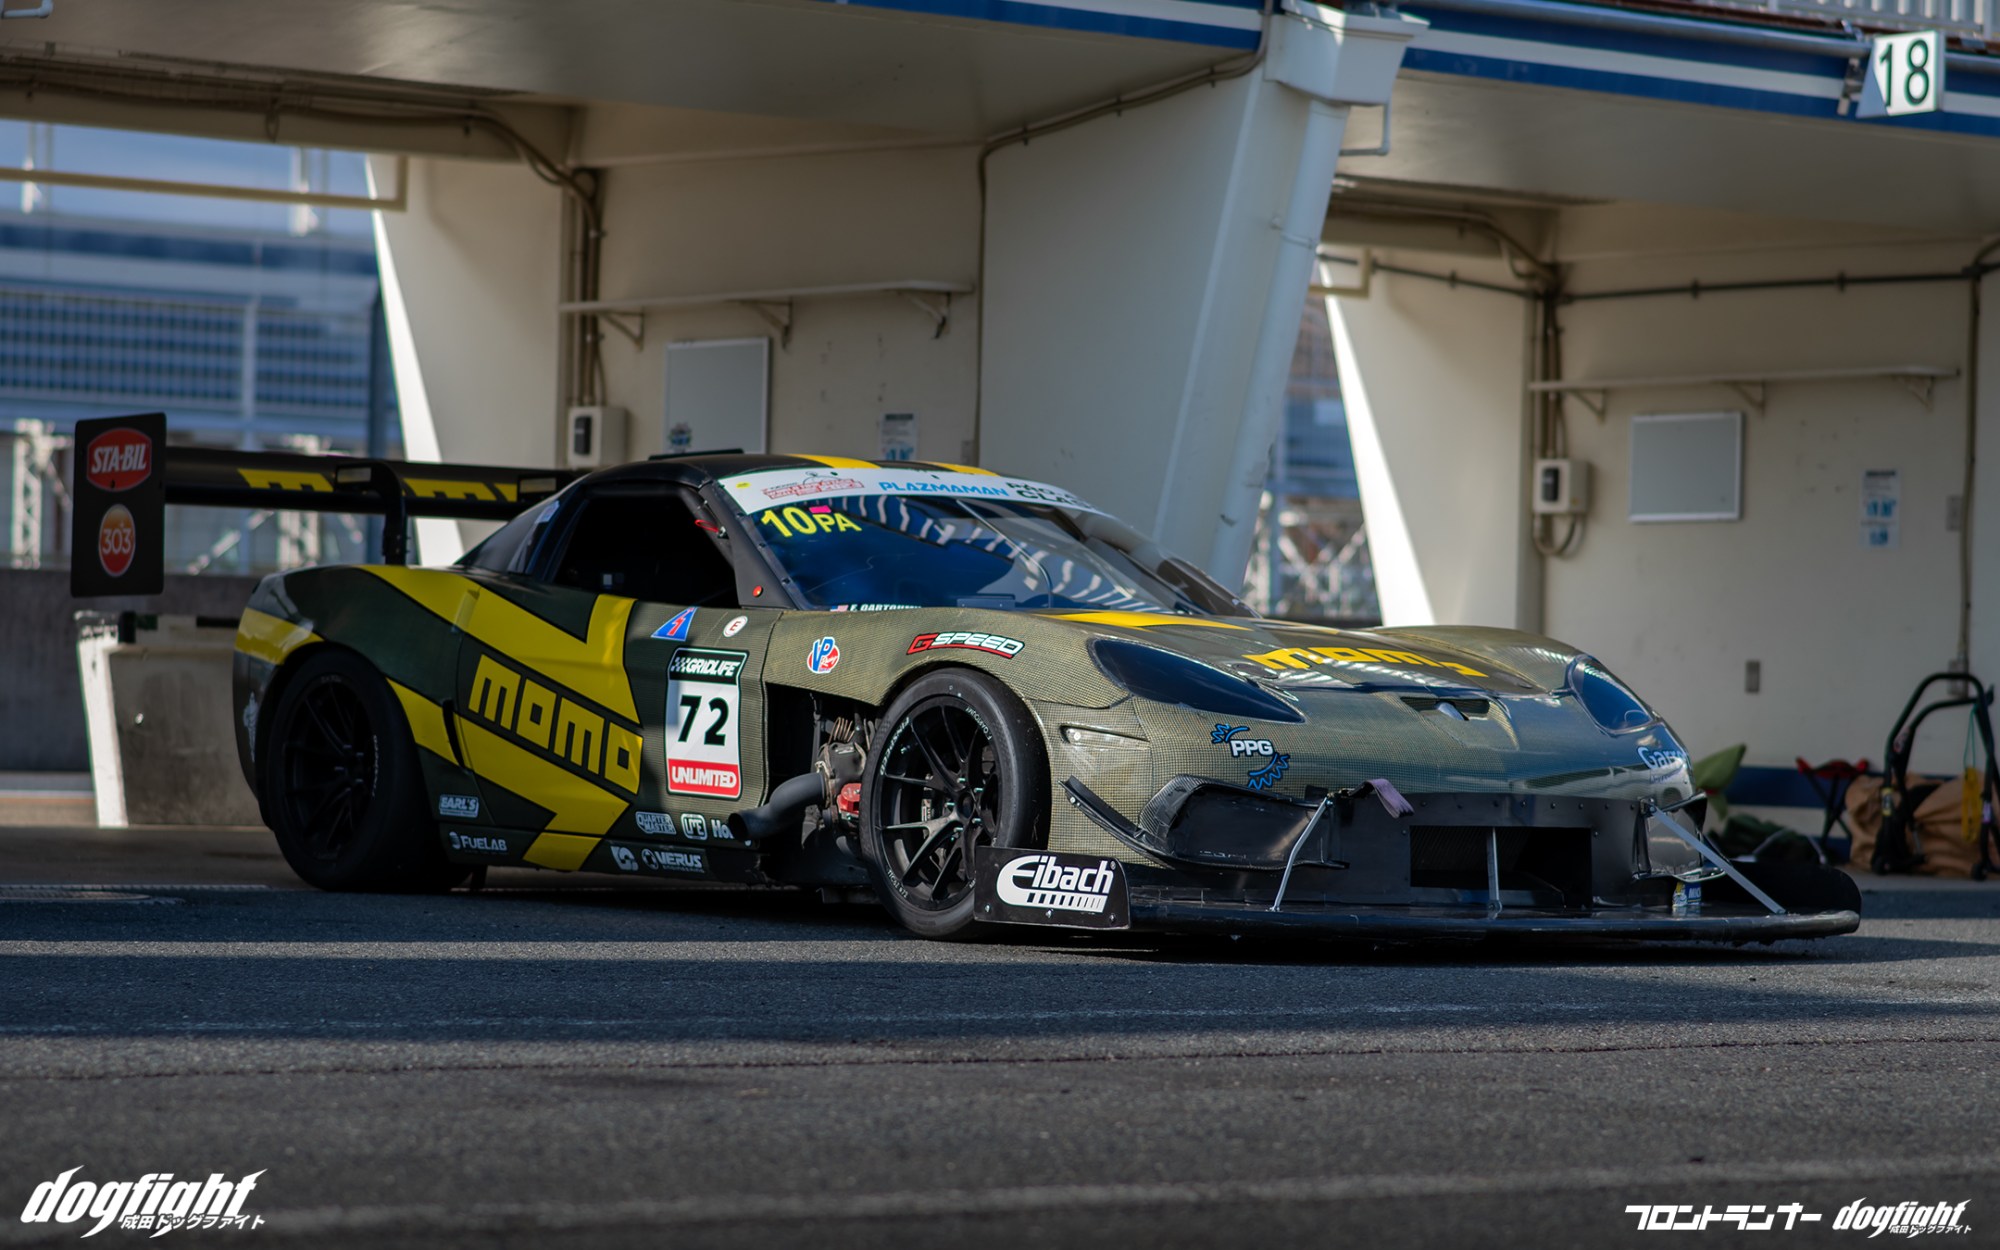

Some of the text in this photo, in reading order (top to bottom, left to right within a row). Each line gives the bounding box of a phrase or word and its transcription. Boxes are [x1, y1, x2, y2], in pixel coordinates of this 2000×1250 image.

[1879, 39, 1930, 107] 18
[878, 481, 1010, 497] PLAZMAMAN
[761, 506, 863, 537] 10 PA
[102, 527, 132, 555] 303
[812, 638, 834, 672] VP
[906, 632, 1024, 657] GSPEED
[685, 658, 741, 677] GRIDLIFE
[677, 694, 730, 747] 72
[1230, 740, 1274, 757] PPG
[671, 766, 738, 789] UNLIMITED
[440, 796, 477, 811] EARL'S
[655, 851, 703, 868] VERUS
[996, 855, 1114, 913] Eibach
